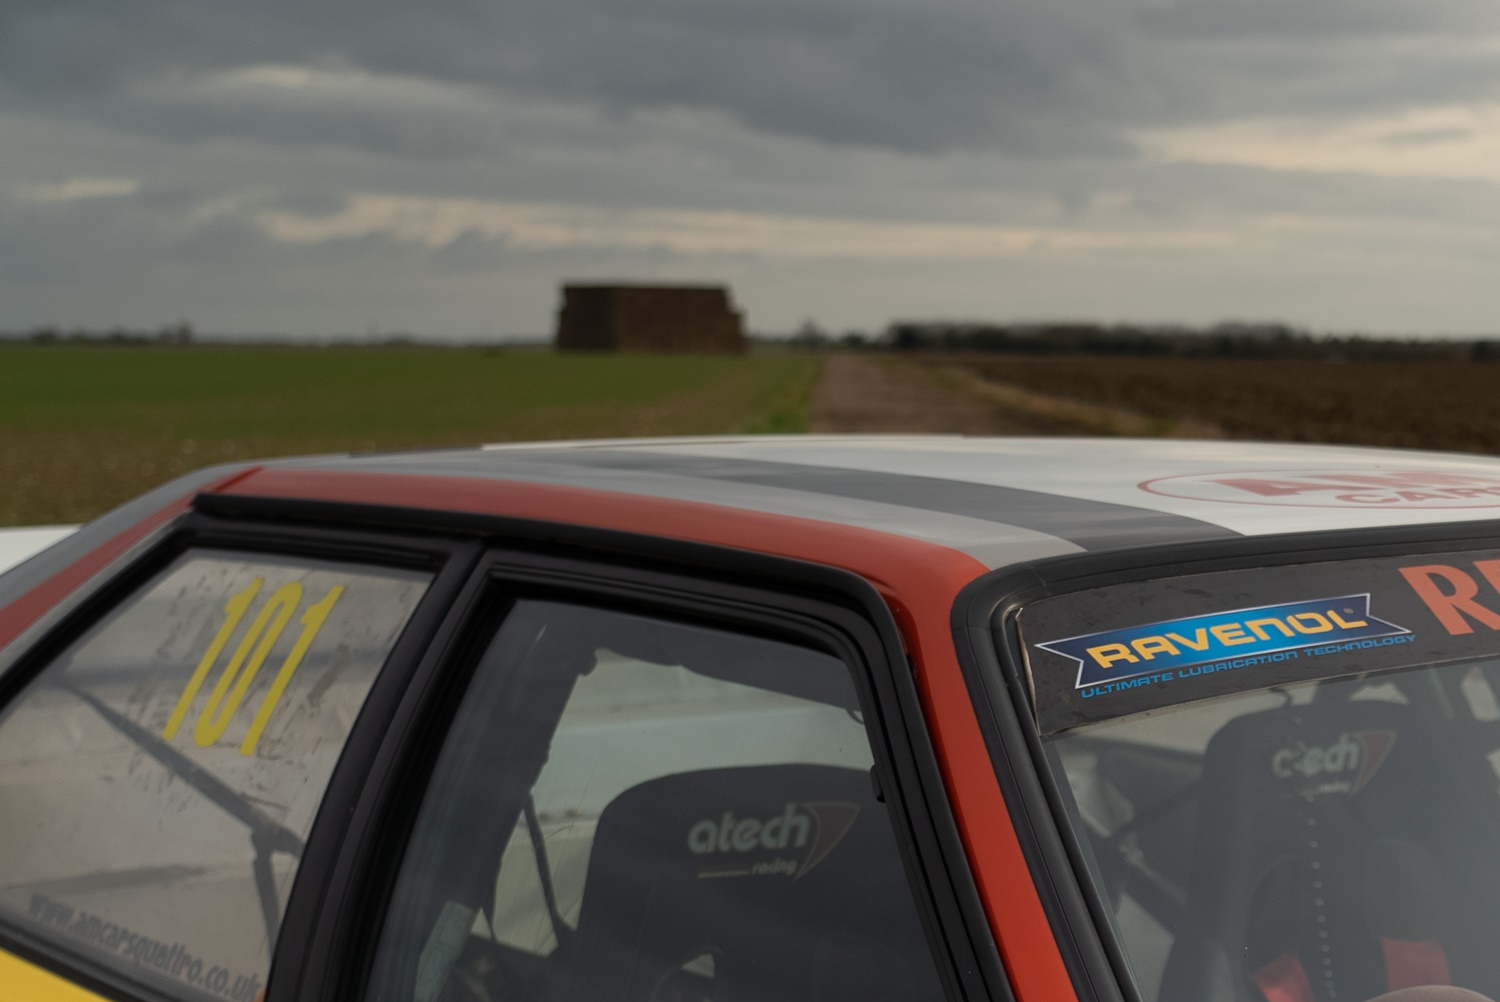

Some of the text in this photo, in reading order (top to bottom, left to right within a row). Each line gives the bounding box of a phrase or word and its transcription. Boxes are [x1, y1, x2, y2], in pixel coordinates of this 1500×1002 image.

[163, 575, 345, 756] 101
[1081, 634, 1416, 699] ULTIMATE LUBRICATION TECHNOLOGY
[687, 803, 811, 854] atech
